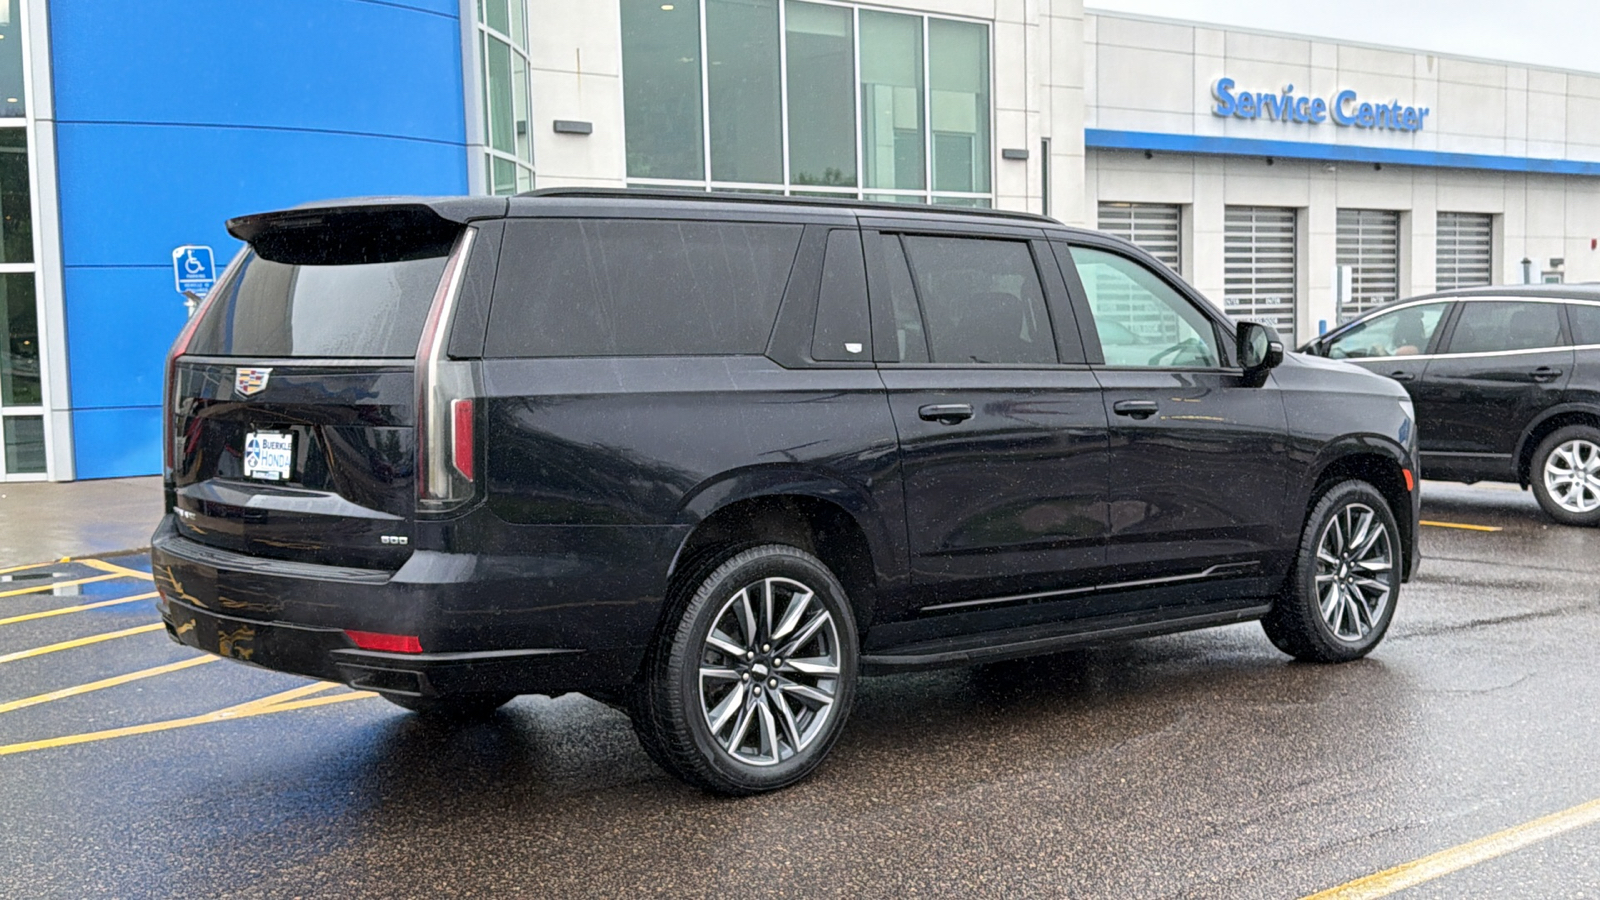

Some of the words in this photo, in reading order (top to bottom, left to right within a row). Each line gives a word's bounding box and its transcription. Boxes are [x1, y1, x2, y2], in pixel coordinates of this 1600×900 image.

[1212, 77, 1326, 124] Service
[1331, 89, 1430, 131] Center
[262, 438, 292, 450] BUERKLE
[261, 450, 291, 467] HONDA
